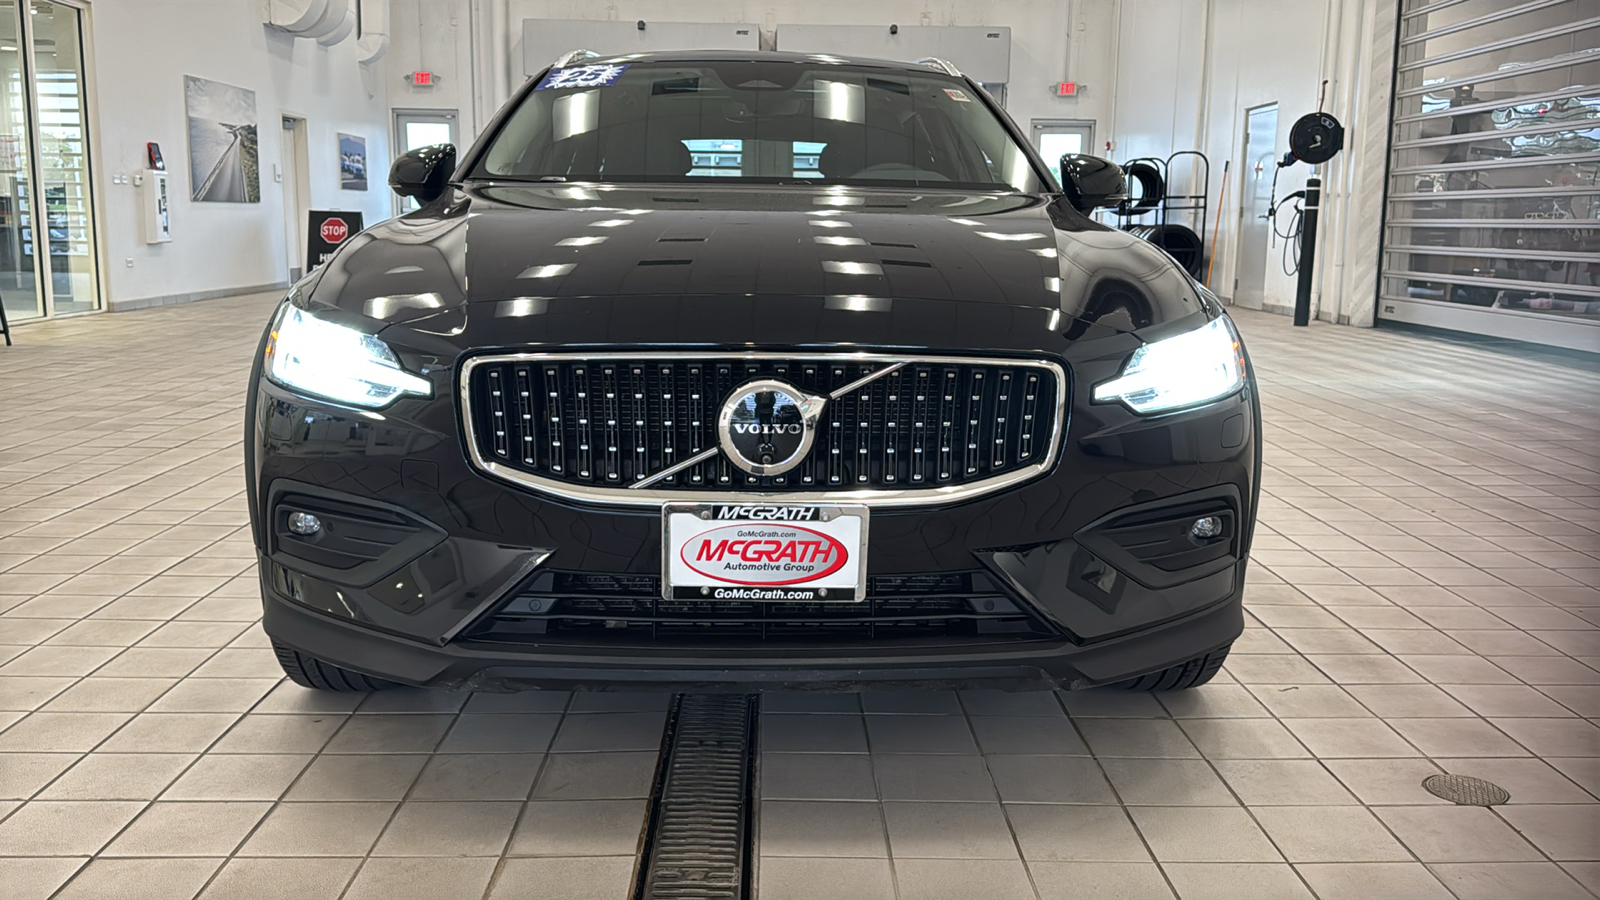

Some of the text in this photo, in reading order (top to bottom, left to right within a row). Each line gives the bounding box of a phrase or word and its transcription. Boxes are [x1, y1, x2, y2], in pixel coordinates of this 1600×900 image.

[415, 71, 430, 84] EXIT
[559, 68, 608, 84] 25
[1060, 82, 1075, 94] EXIT
[322, 225, 346, 236] STOP
[732, 423, 801, 434] VOLVO
[737, 530, 797, 538] GoMcGrath.com
[723, 562, 815, 573] Automotive Group
[714, 588, 814, 600] GoMcGrath.com
